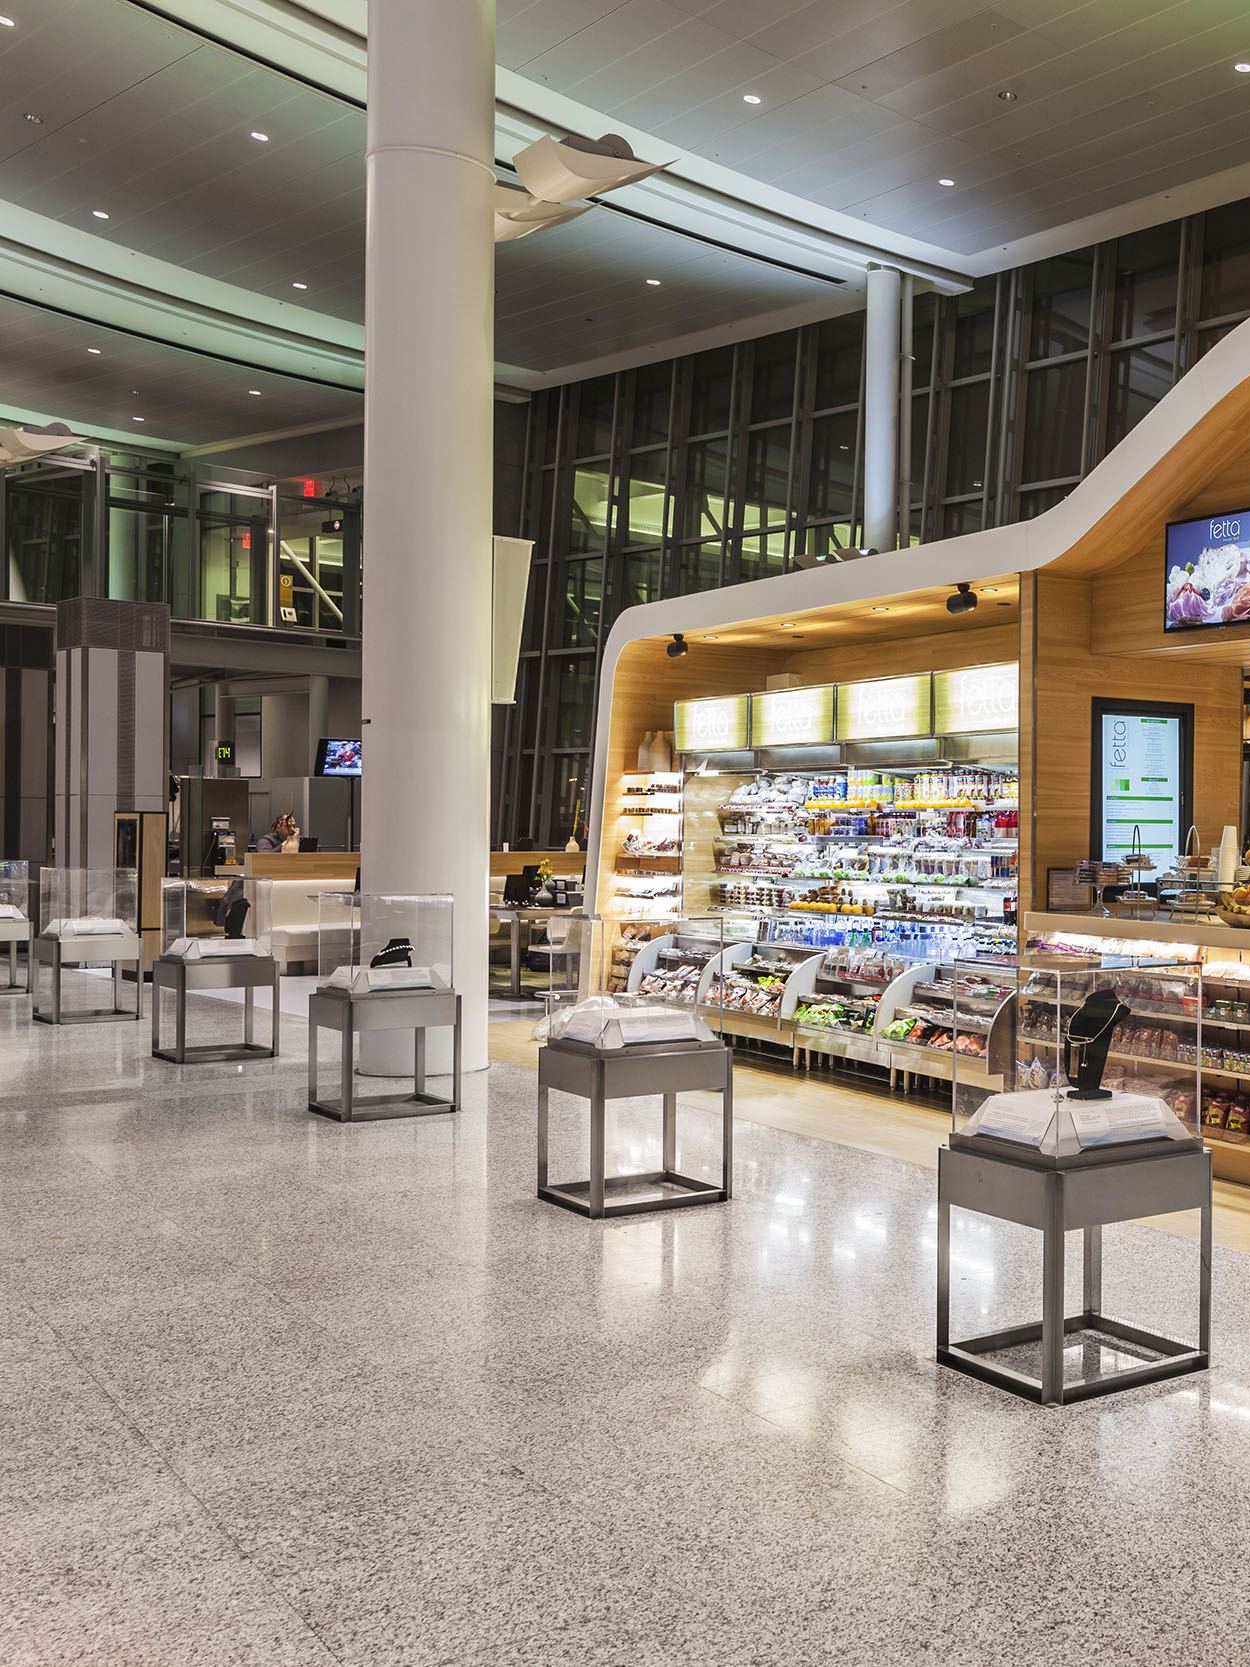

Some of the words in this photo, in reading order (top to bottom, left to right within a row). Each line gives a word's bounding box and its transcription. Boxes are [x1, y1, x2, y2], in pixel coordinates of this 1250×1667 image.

[1209, 519, 1240, 540] fetta
[218, 747, 230, 758] E74
[1110, 720, 1127, 768] fetta
